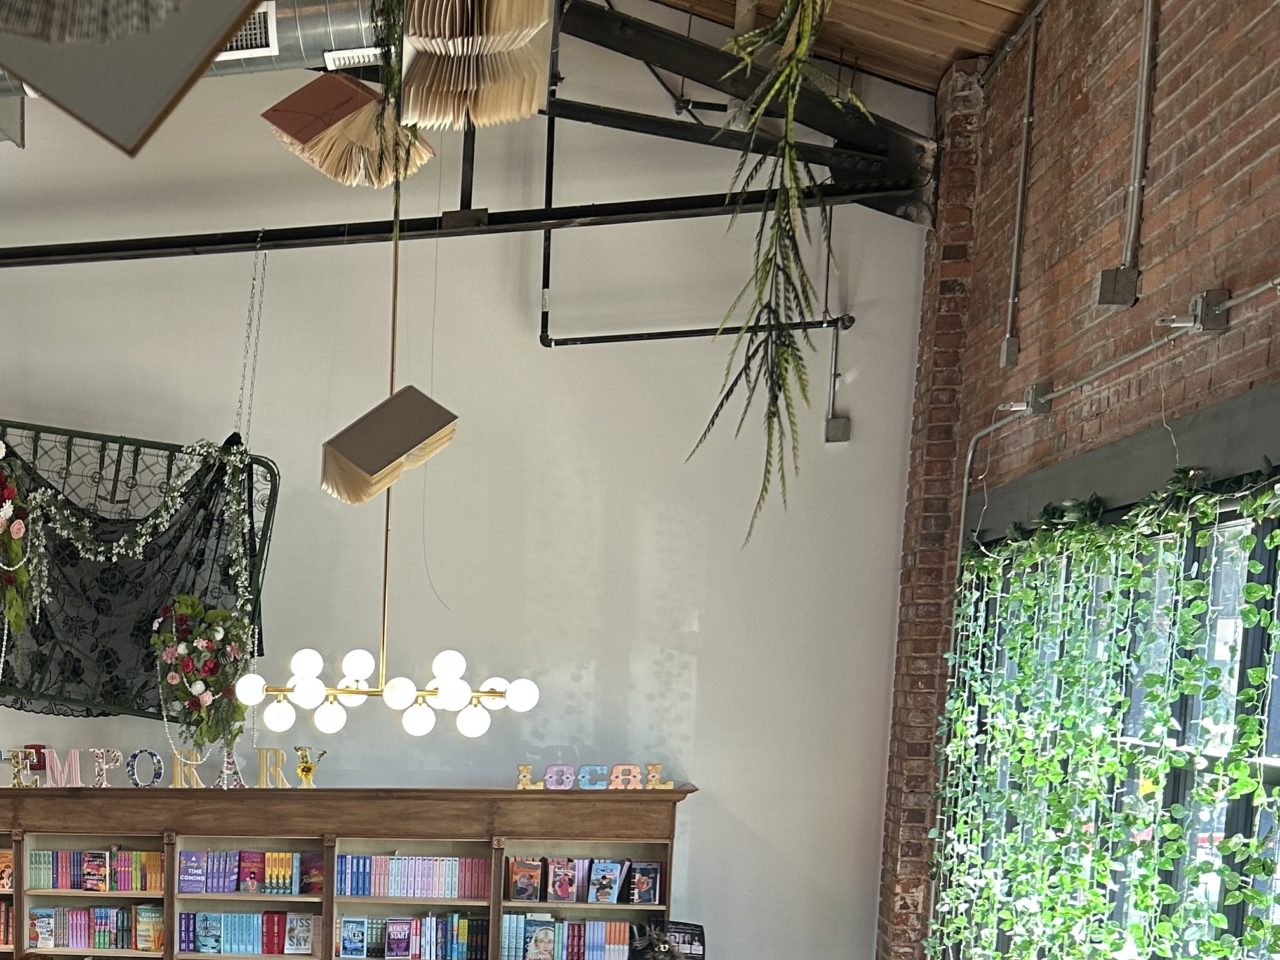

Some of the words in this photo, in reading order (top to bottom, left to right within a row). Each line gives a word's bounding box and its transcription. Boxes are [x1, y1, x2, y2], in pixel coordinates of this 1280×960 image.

[516, 763, 674, 790] LOCAL
[289, 917, 310, 928] KISS
[289, 935, 308, 947] SKY
